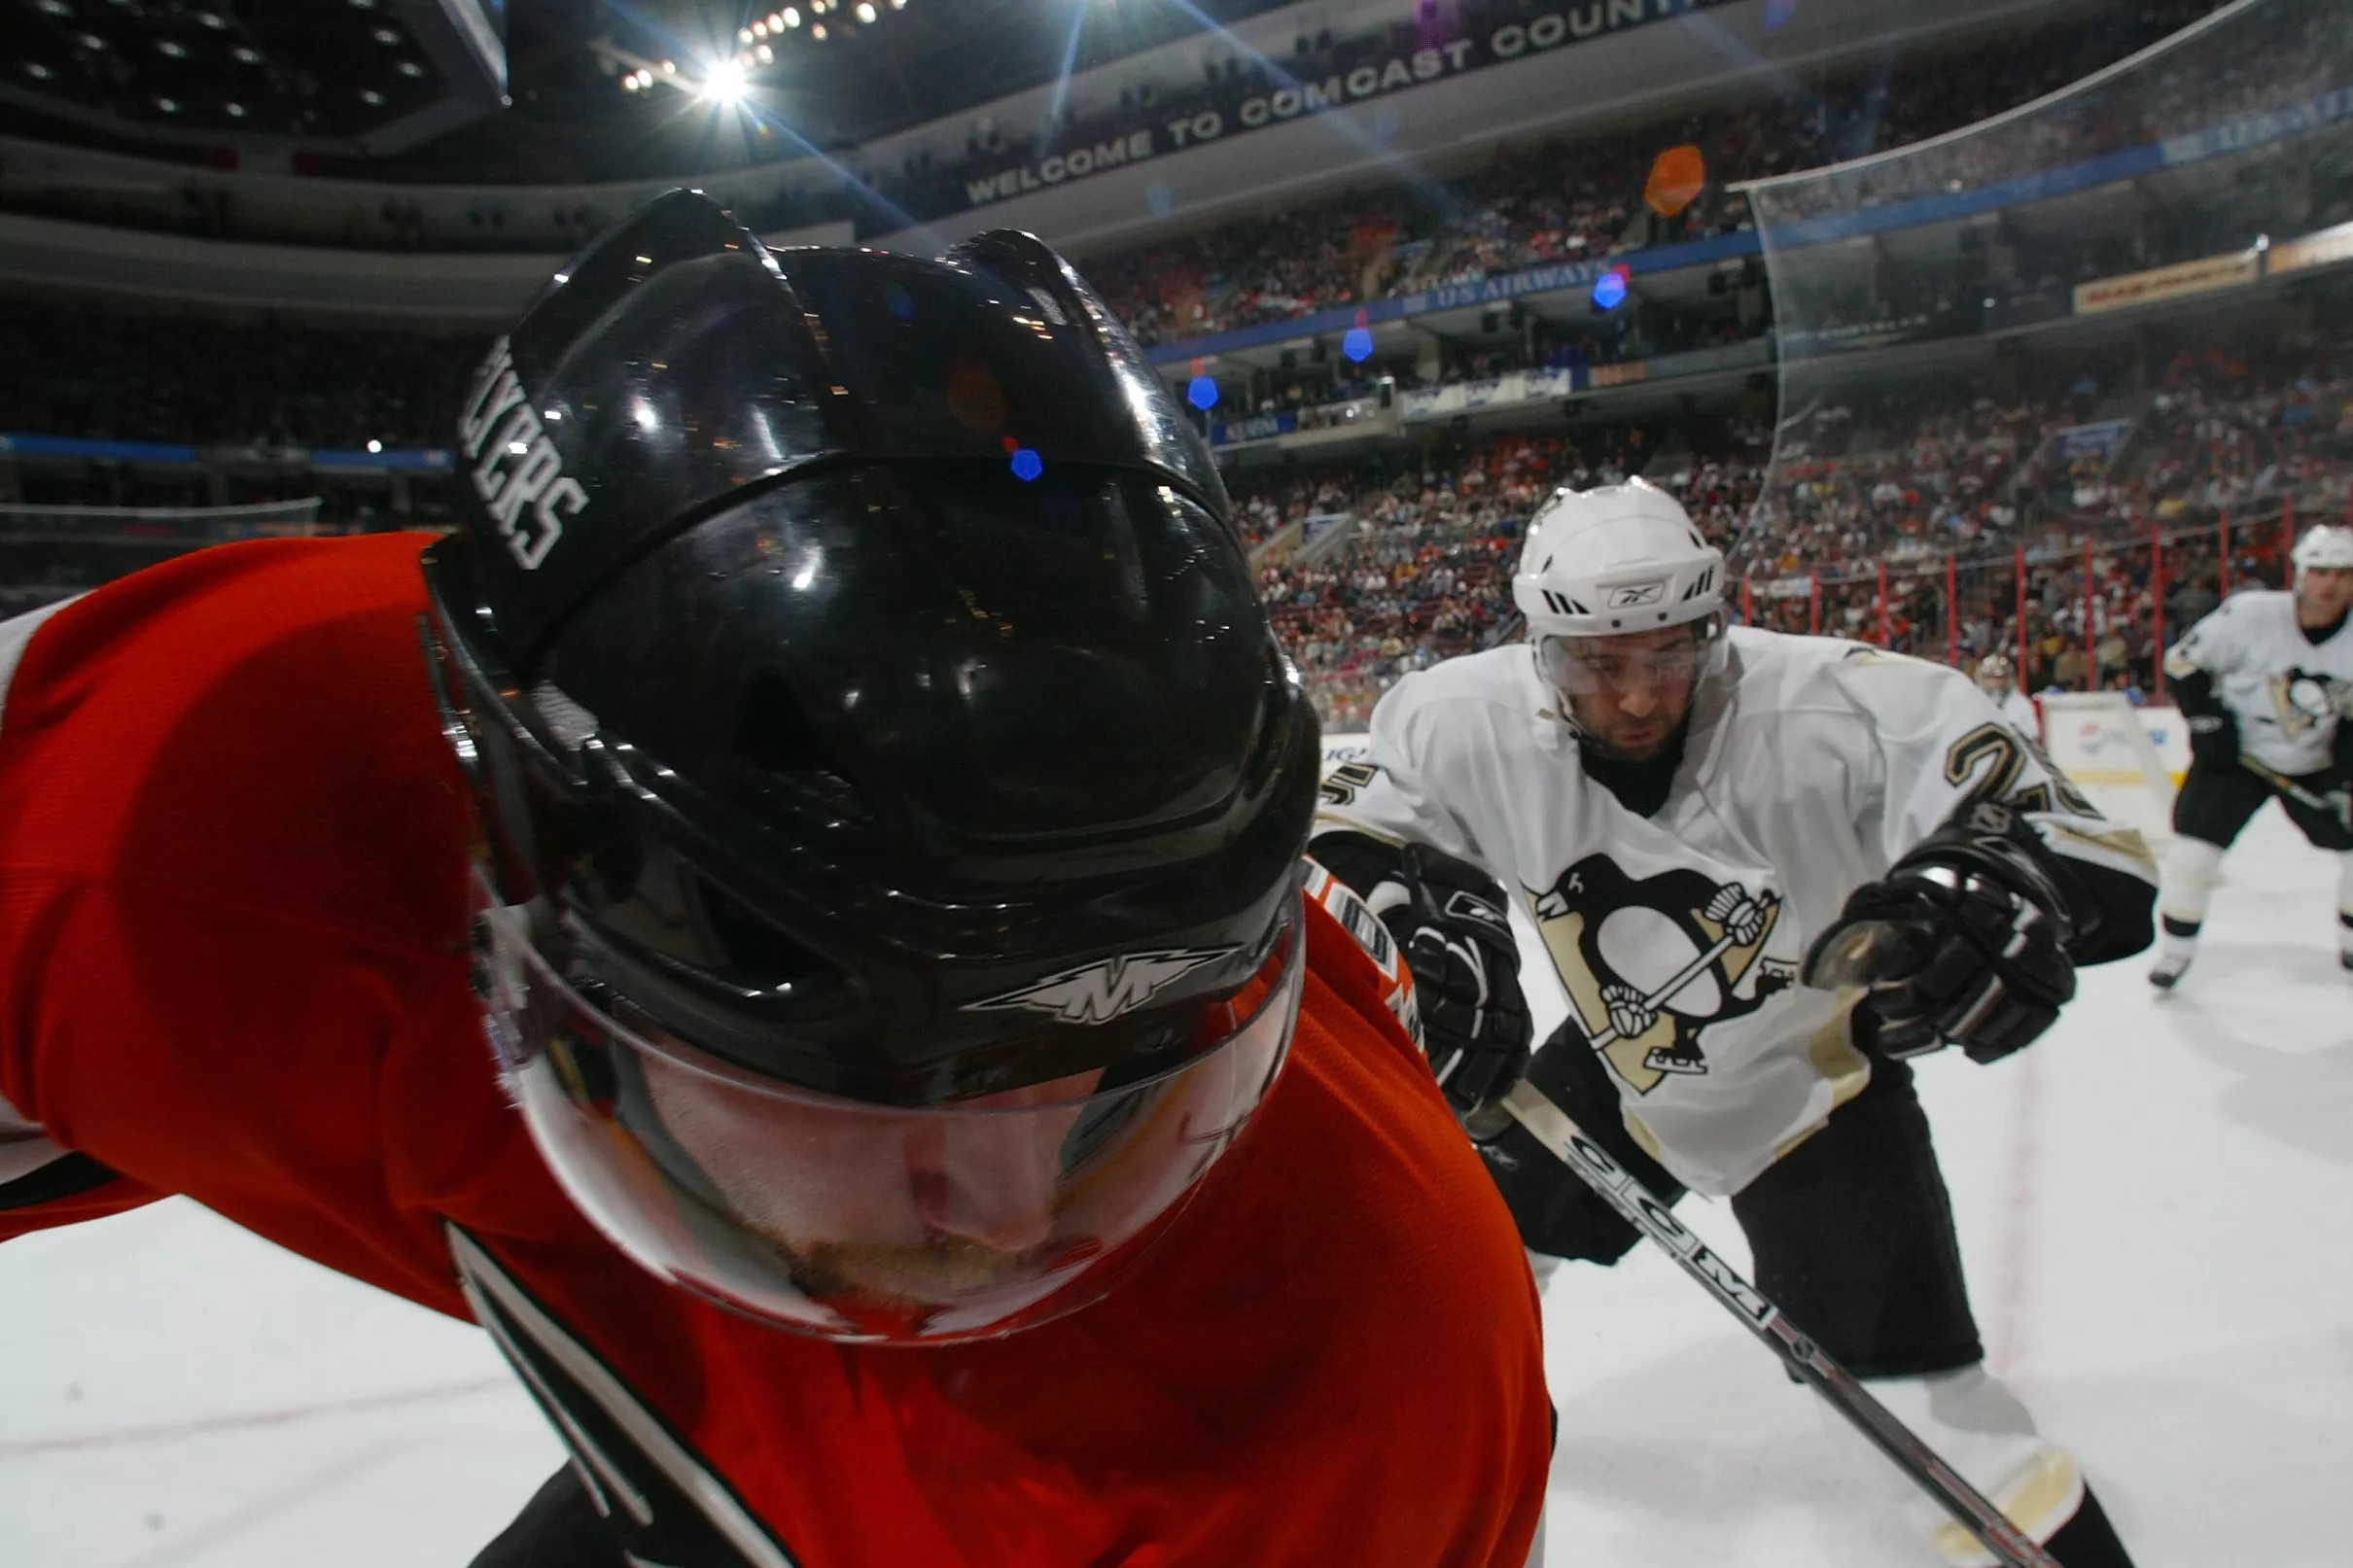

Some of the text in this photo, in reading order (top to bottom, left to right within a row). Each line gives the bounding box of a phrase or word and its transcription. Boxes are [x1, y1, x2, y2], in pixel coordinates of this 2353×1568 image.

[966, 130, 1154, 205] WELCOME
[1169, 111, 1223, 147] TO
[1240, 38, 1474, 126] COMCAST
[1562, 1134, 1774, 1322] CCM
